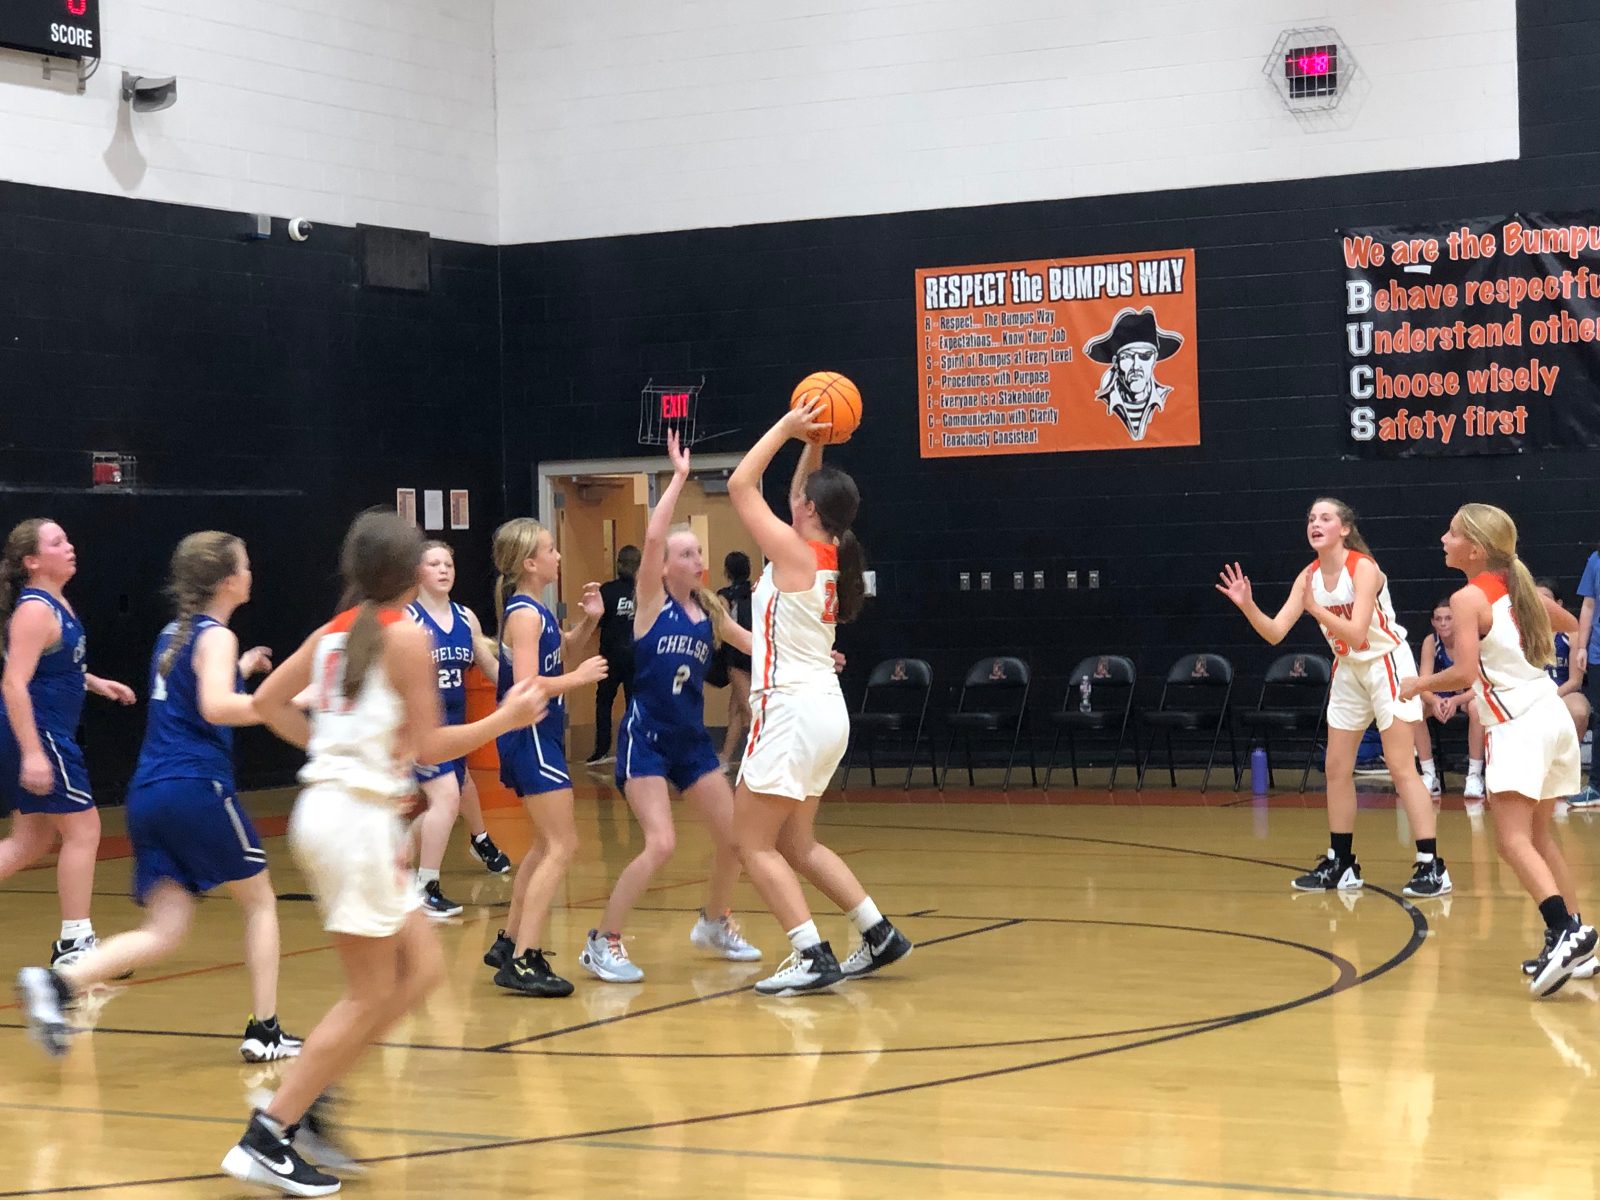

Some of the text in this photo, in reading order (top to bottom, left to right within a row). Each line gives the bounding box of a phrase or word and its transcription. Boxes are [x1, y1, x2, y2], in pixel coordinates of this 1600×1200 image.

[51, 23, 93, 48] SCORE
[1343, 235, 1385, 269] We
[1392, 238, 1440, 265] are
[1446, 227, 1496, 260] the
[925, 257, 1185, 309] RESPECT the BUMPUS WAY
[1346, 277, 1458, 315] Behave
[925, 316, 931, 331] R
[984, 312, 998, 327] The
[1001, 311, 1034, 328] Bumpus
[1036, 308, 1055, 325] Way
[925, 336, 930, 351] E
[1002, 330, 1025, 346] Know
[1027, 328, 1048, 344] Your
[1050, 327, 1066, 343] Job
[1346, 313, 1522, 357] Understand
[926, 355, 932, 370] S
[941, 353, 964, 372] Spirit
[967, 352, 976, 368] of
[978, 352, 1011, 370] Bumpus
[1013, 349, 1022, 365] at
[1025, 348, 1048, 366] Every
[1050, 346, 1073, 362] Level
[927, 374, 933, 391] P
[941, 372, 991, 389] Procedures
[992, 371, 1011, 386] with
[1014, 370, 1049, 387] Purpose
[1350, 358, 1560, 400] Choose wisely
[662, 394, 689, 418] EXIT
[927, 394, 932, 409] E
[940, 393, 978, 410] Everyone
[980, 391, 988, 406] is
[990, 393, 996, 406] a
[998, 388, 1050, 406] Stakeholder
[928, 413, 934, 428] C
[942, 409, 1006, 428] Communication
[1008, 408, 1027, 425] with
[1029, 406, 1059, 425] Clarity
[1350, 405, 1528, 444] Safety first
[928, 432, 933, 448] T
[942, 430, 990, 448] Tenaciously
[993, 427, 1038, 444] Consistent
[657, 635, 709, 665] CHELSE
[438, 669, 462, 689] 23
[672, 664, 691, 695] 2
